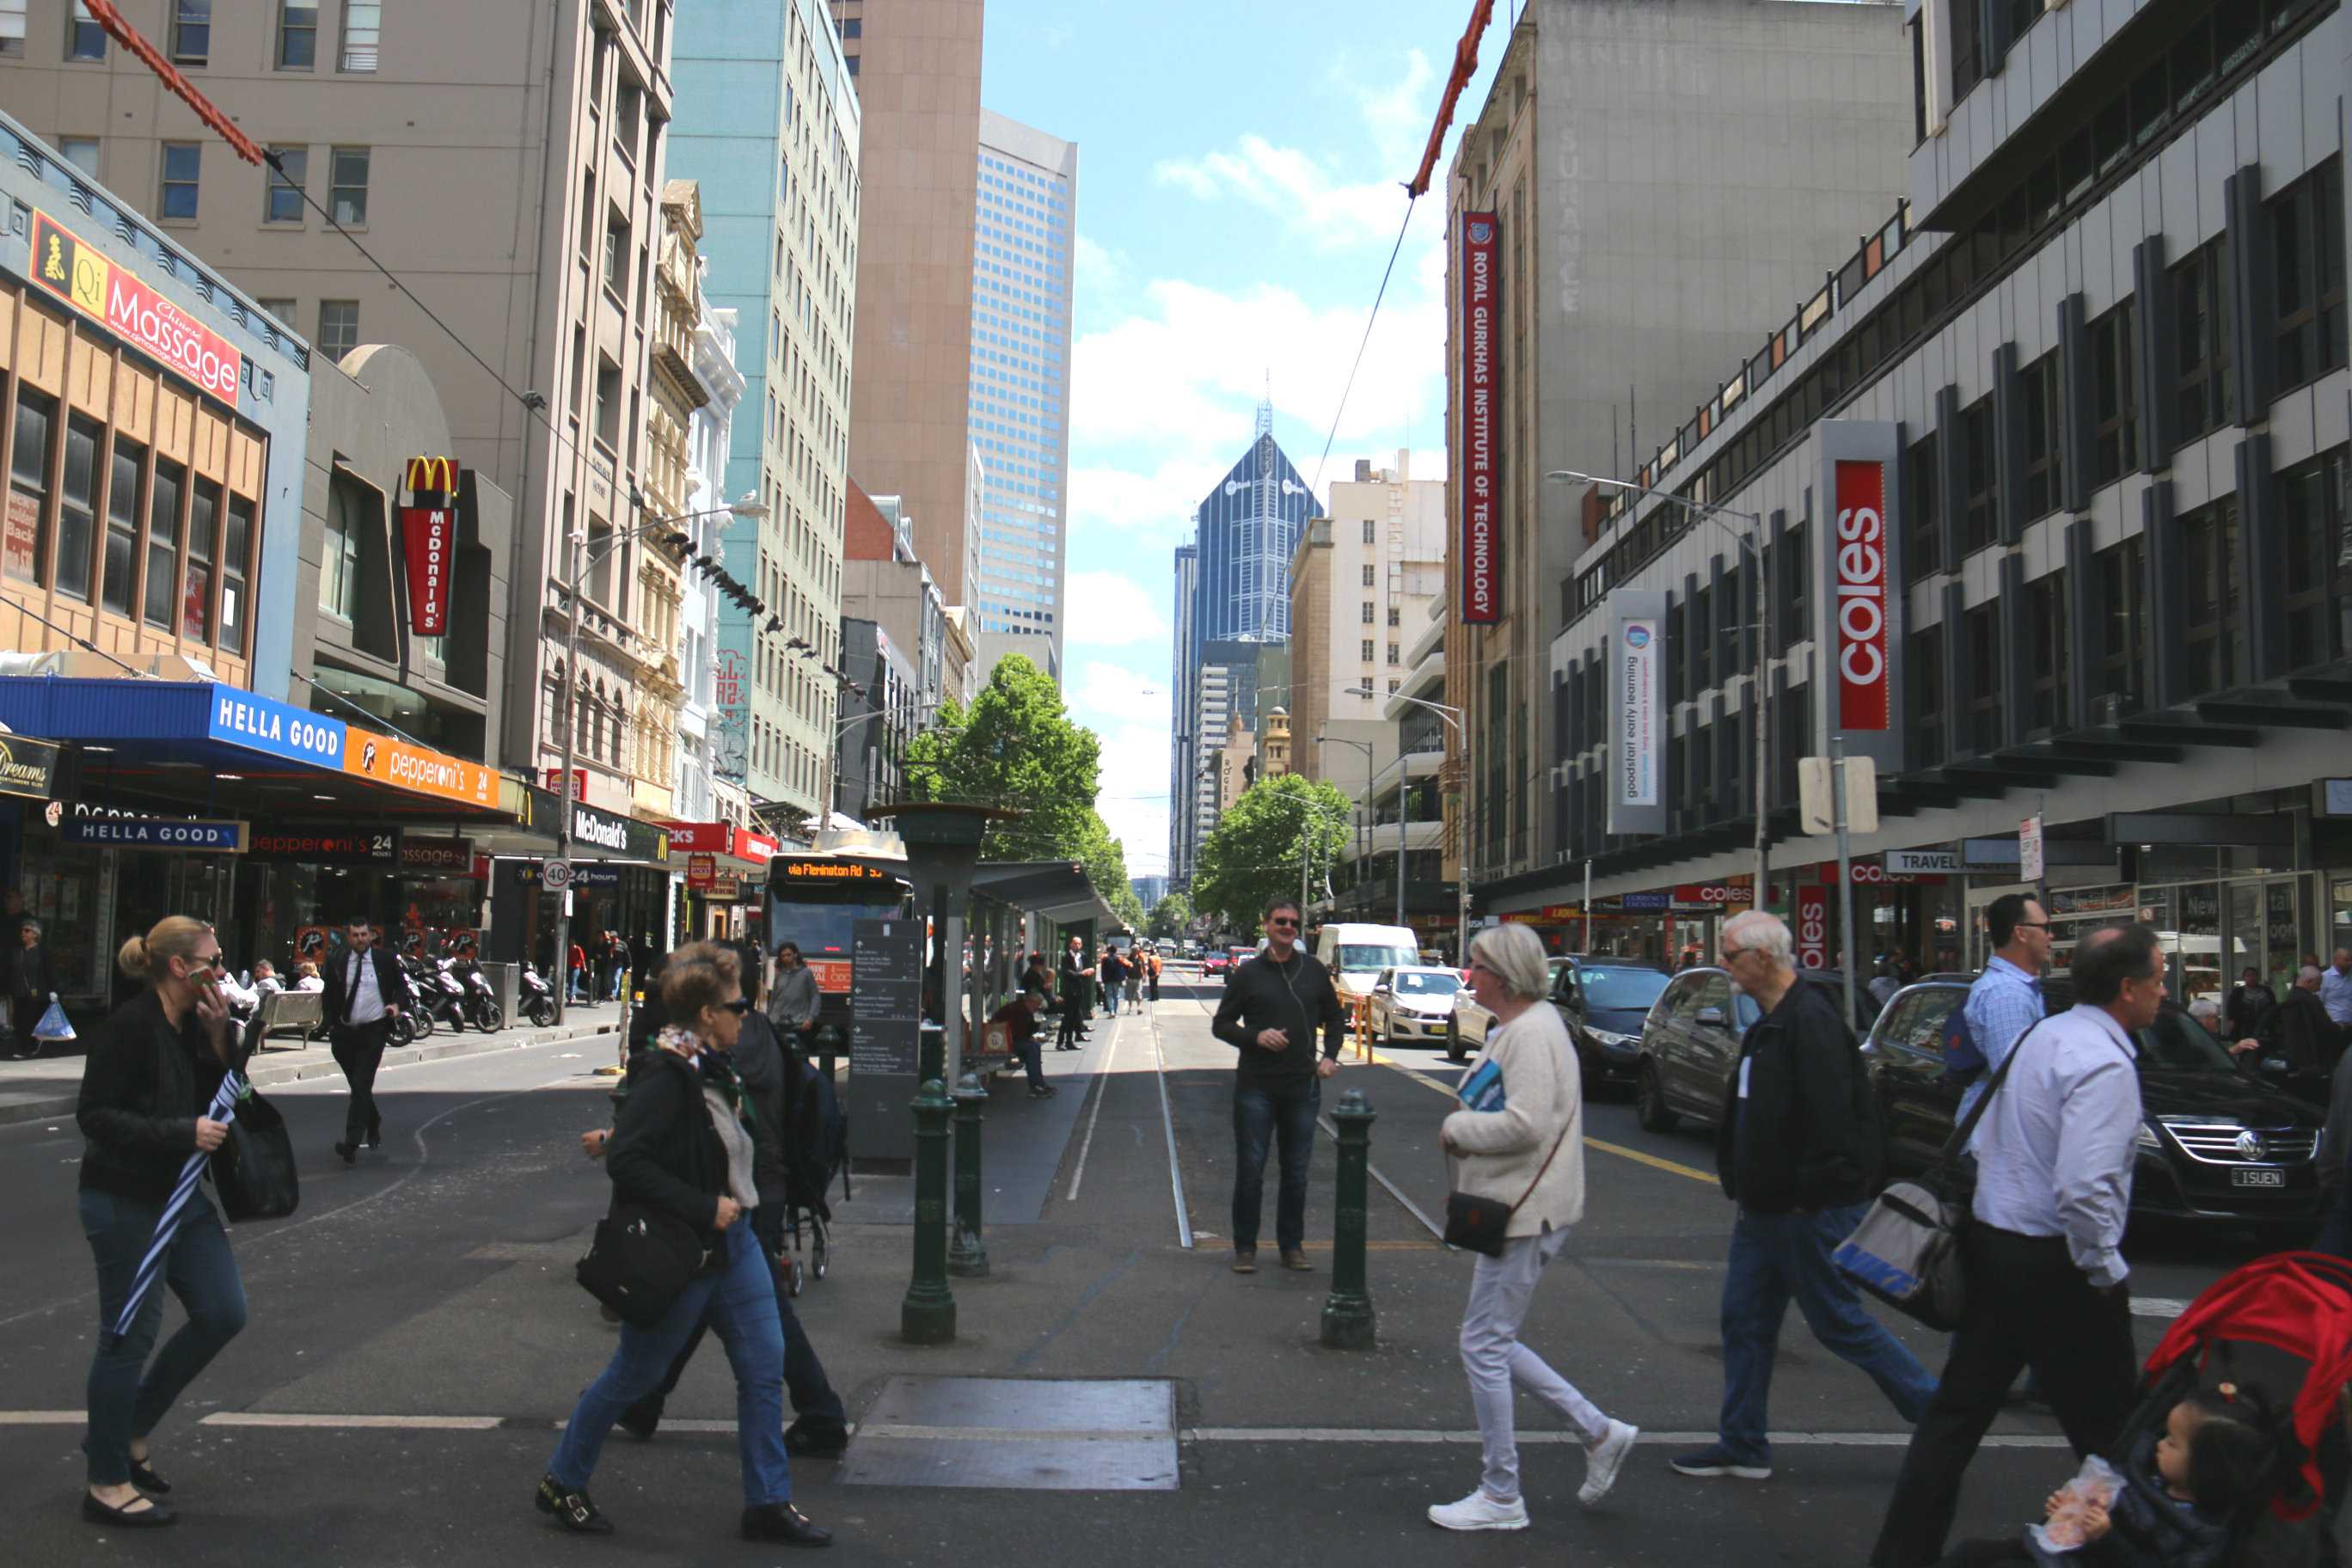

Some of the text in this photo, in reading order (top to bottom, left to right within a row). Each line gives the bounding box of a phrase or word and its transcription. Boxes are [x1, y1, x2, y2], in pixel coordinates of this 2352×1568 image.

[77, 259, 101, 305] Qi
[109, 279, 236, 393] Massage
[156, 302, 202, 340] Chinese
[109, 319, 201, 380] www.qimassage.com.au
[1473, 251, 1489, 615] ROYAL GURKHAS INSTITUTE OF TECHNOLOGY
[6, 521, 34, 545] Back
[425, 511, 444, 628] McDonald's
[1837, 507, 1883, 686] coles
[218, 697, 338, 756] HELLA GOOD
[1626, 656, 1638, 799] goodstart early learning
[390, 750, 465, 792] pepperoni's
[477, 771, 488, 791] 24
[47, 802, 62, 817] 24
[83, 824, 218, 842] HELLA GOOD
[372, 835, 392, 850] 24
[575, 809, 627, 851] McDonald's
[669, 830, 695, 843] CK'S
[402, 848, 453, 865] assage
[788, 863, 802, 875] via
[803, 863, 849, 877] Flemington
[849, 865, 863, 877] Rd
[1901, 854, 1957, 869] TRAVEL
[547, 867, 565, 881] 40
[568, 868, 618, 883] 24 hours
[1700, 885, 1754, 902] coles
[2188, 897, 2217, 916] New
[1802, 903, 1823, 970] oles
